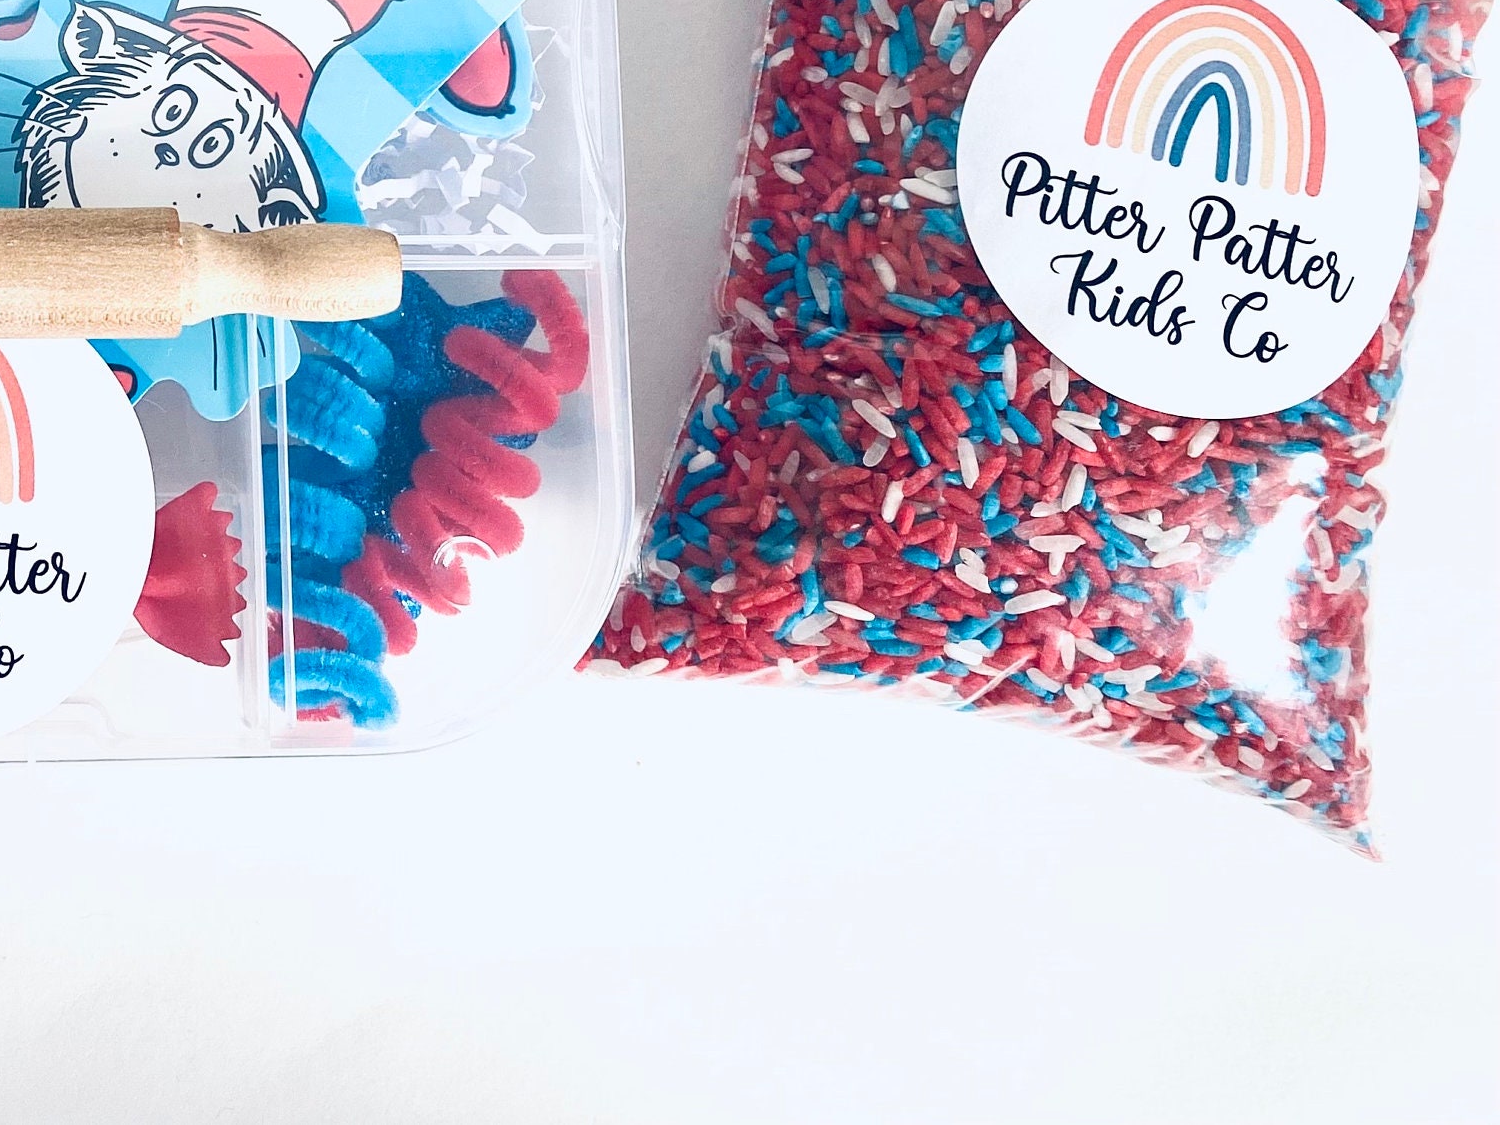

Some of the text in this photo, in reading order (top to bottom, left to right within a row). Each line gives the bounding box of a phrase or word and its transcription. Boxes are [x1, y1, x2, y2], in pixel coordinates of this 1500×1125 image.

[1001, 152, 1355, 303] Pitter Patter
[1050, 249, 1289, 363] Kids Co
